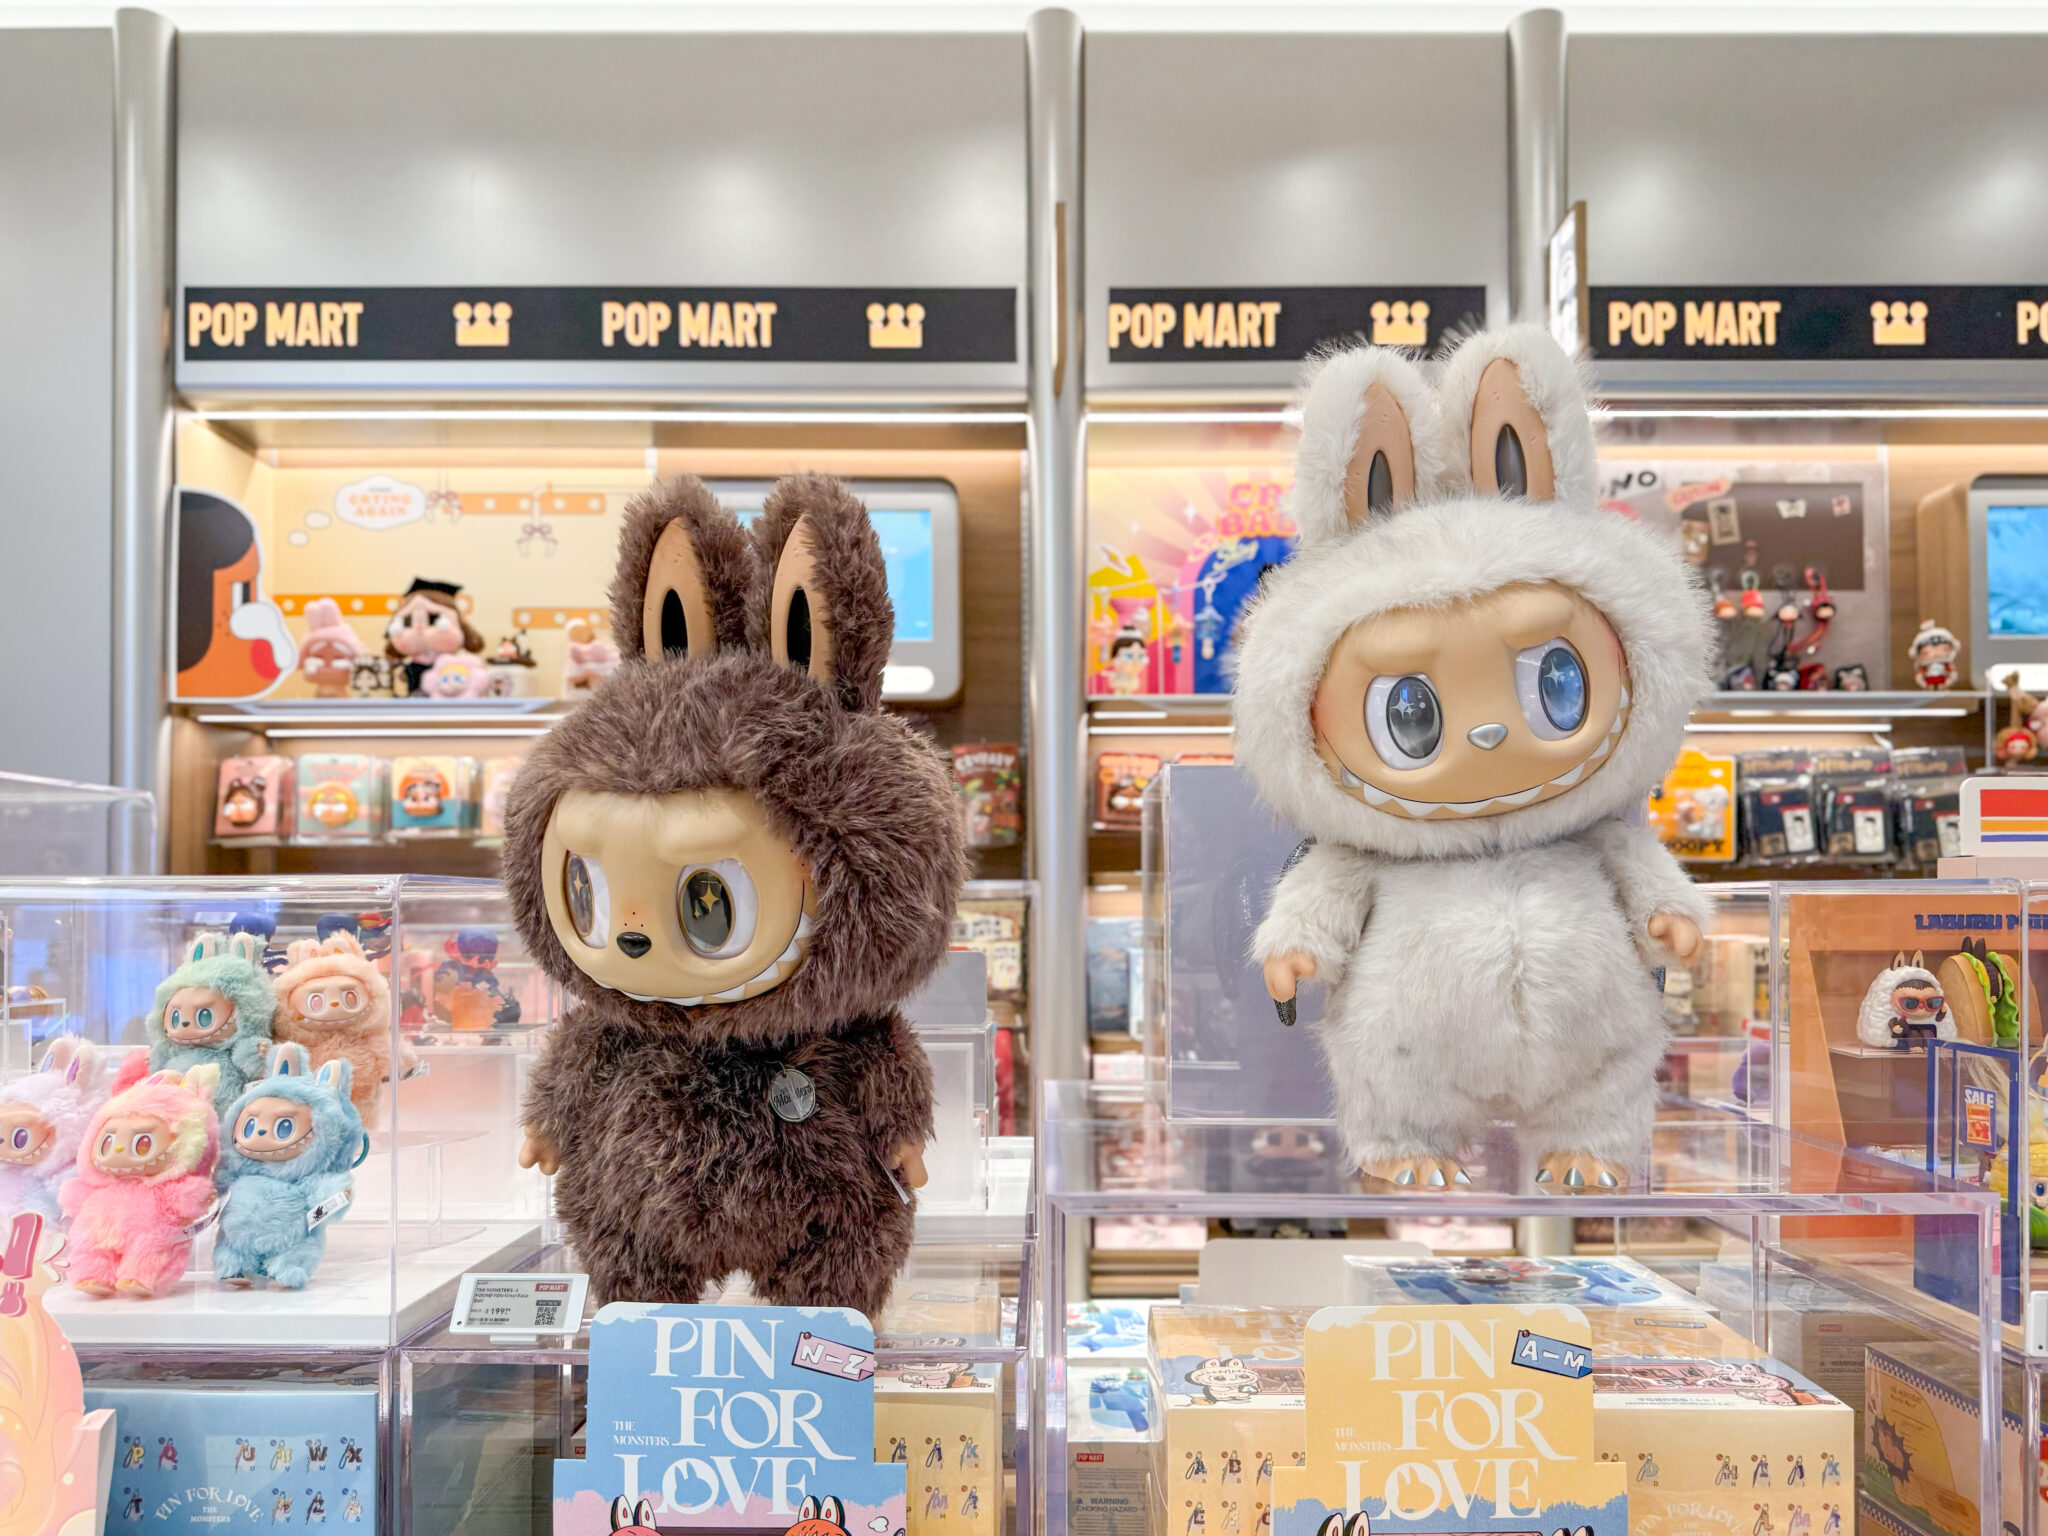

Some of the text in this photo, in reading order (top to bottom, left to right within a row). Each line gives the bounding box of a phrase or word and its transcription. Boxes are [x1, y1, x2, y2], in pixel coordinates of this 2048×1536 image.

[188, 302, 364, 347] POP MART
[602, 301, 777, 348] POP MART
[1108, 302, 1281, 348] POP MART
[1608, 301, 1781, 346] POP MART
[1914, 914, 2003, 930] LABUBU
[1964, 1089, 1994, 1109] SALE
[642, 1316, 784, 1380] PIN
[1360, 1319, 1501, 1380] PIN
[613, 1420, 636, 1432] THE
[613, 1435, 670, 1447] MONSTERS
[671, 1387, 857, 1460] FOR
[1334, 1427, 1356, 1438] THE
[1392, 1389, 1578, 1461] FOR
[1334, 1441, 1392, 1452] MONSTERS
[155, 1487, 265, 1523] PIN FOR LOVE
[613, 1454, 816, 1516] LOVE
[1090, 1497, 1128, 1505] WARNING
[1335, 1458, 1541, 1521] LOVE
[190, 1516, 231, 1524] MONSTERS
[202, 1506, 218, 1514] THE
